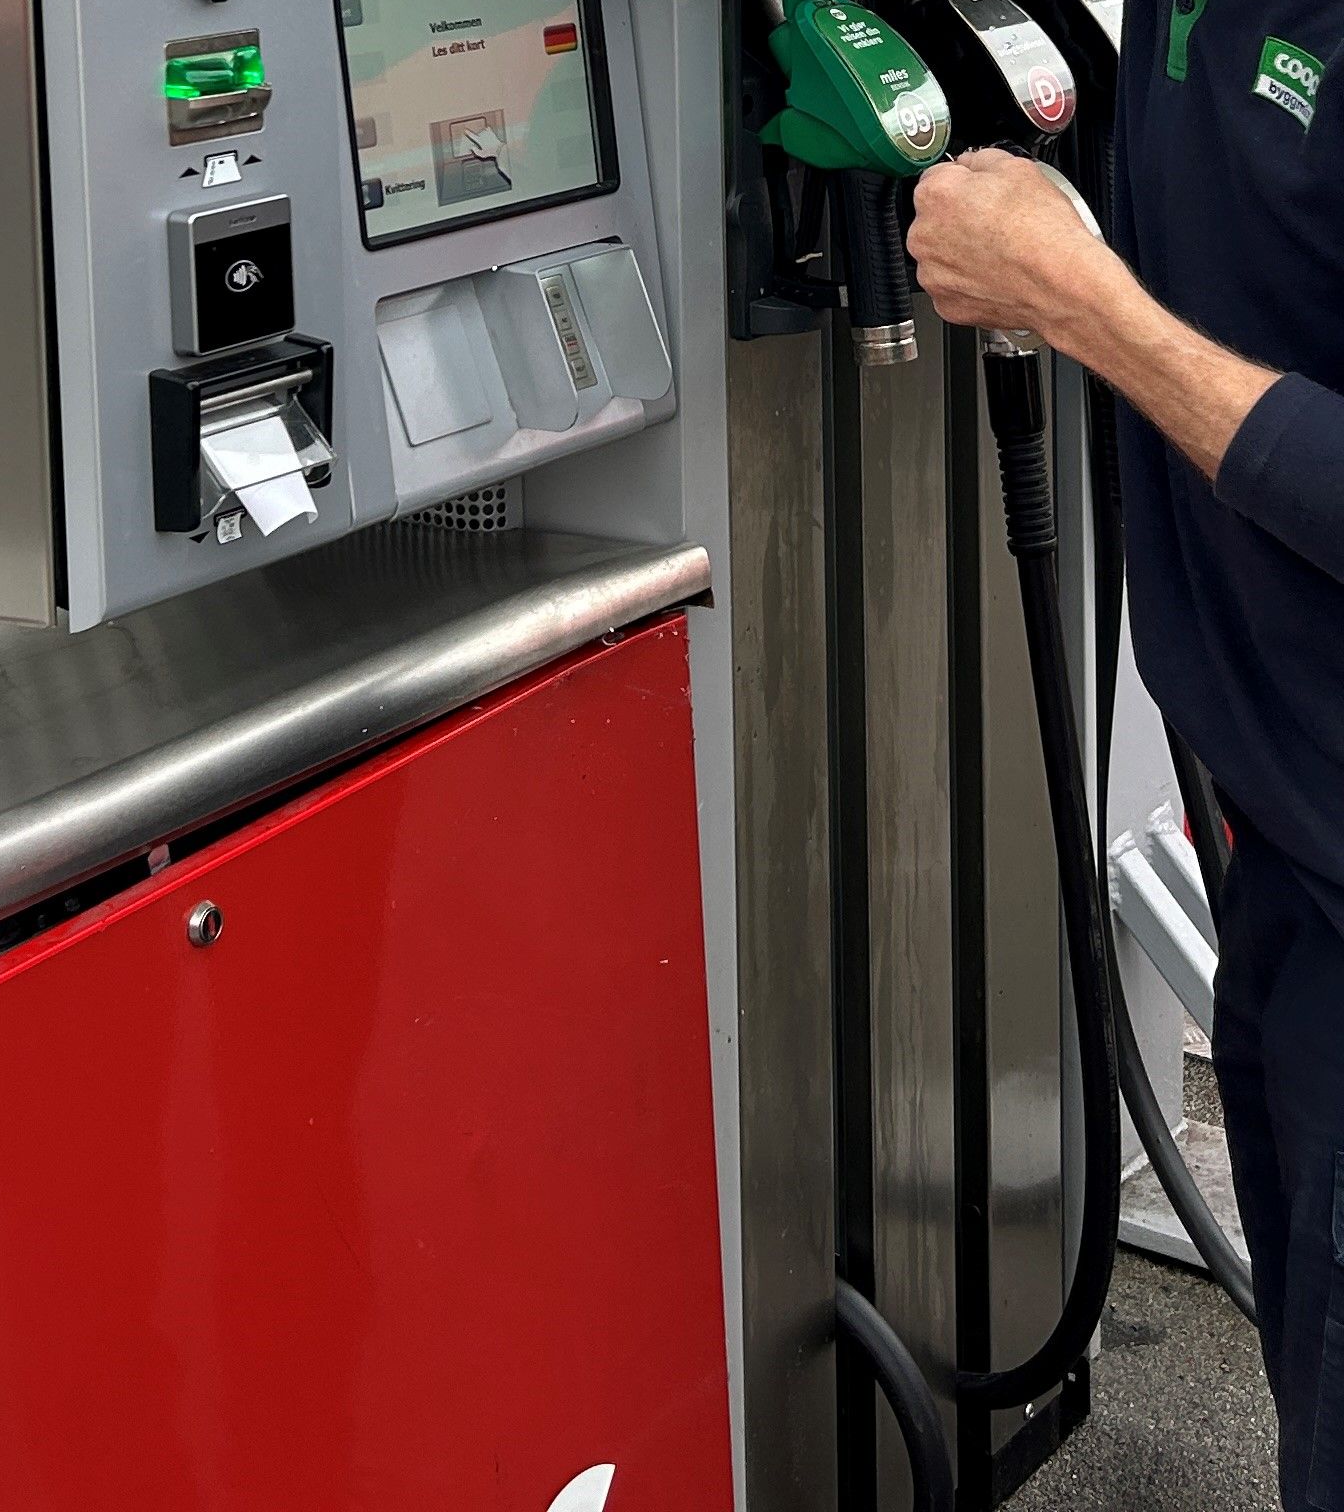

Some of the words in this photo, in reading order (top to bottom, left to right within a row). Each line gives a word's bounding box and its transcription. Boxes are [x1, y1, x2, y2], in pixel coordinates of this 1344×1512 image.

[429, 18, 482, 34] Velkommen
[432, 45, 447, 58] Les
[466, 39, 486, 52] kort
[879, 68, 909, 85] miles
[1273, 52, 1320, 97] coop
[1034, 78, 1056, 108] D
[899, 103, 932, 137] 95
[385, 179, 426, 196] Kvittering
